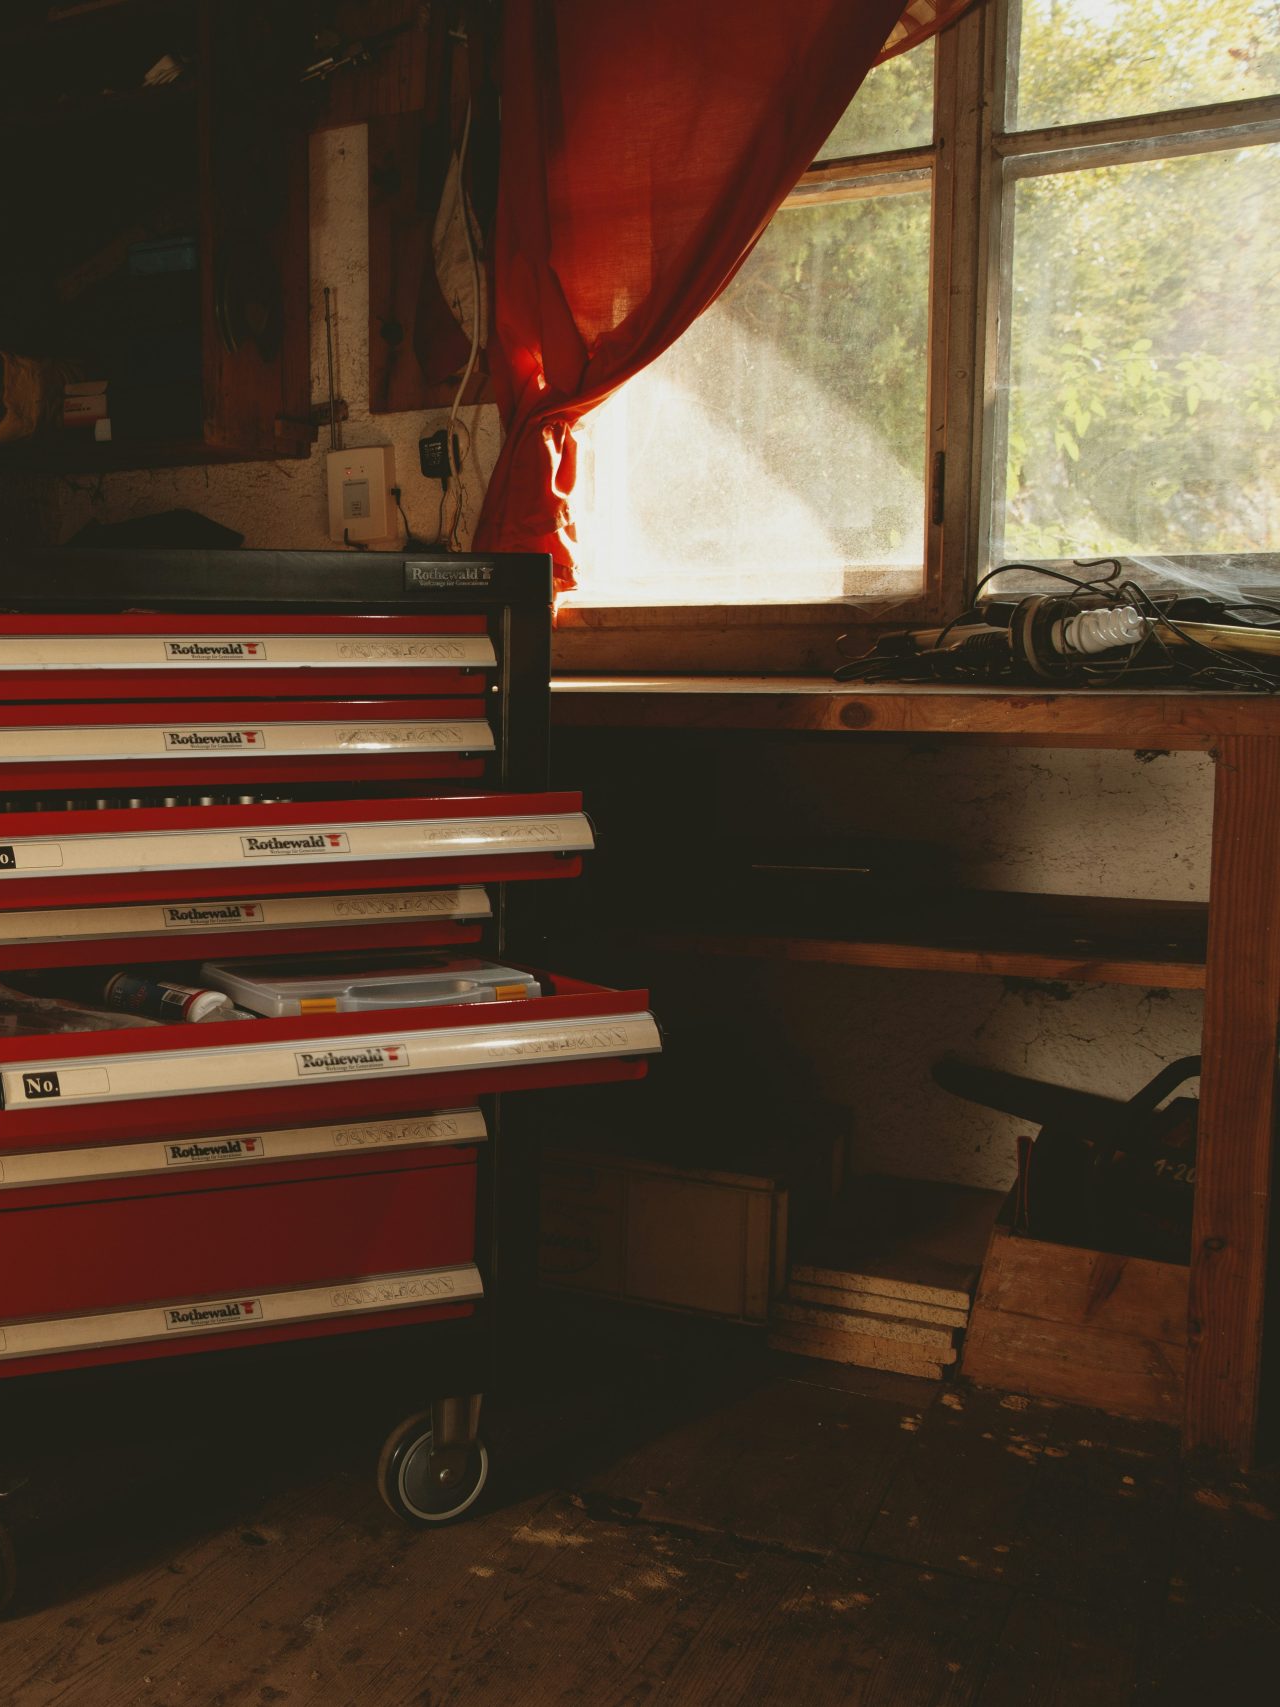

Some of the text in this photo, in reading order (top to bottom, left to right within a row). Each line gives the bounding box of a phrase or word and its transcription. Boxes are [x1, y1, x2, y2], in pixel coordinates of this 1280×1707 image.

[412, 567, 478, 580] Rothewald
[170, 643, 243, 655] Rothewald
[169, 733, 242, 744] Rothewald
[247, 835, 325, 850] Rothewald
[168, 906, 241, 921] Rothewald
[301, 1048, 384, 1068] Rothewald
[26, 1078, 59, 1094] No.
[170, 1141, 241, 1158] Rothewald
[170, 1304, 240, 1323] Rothewald
